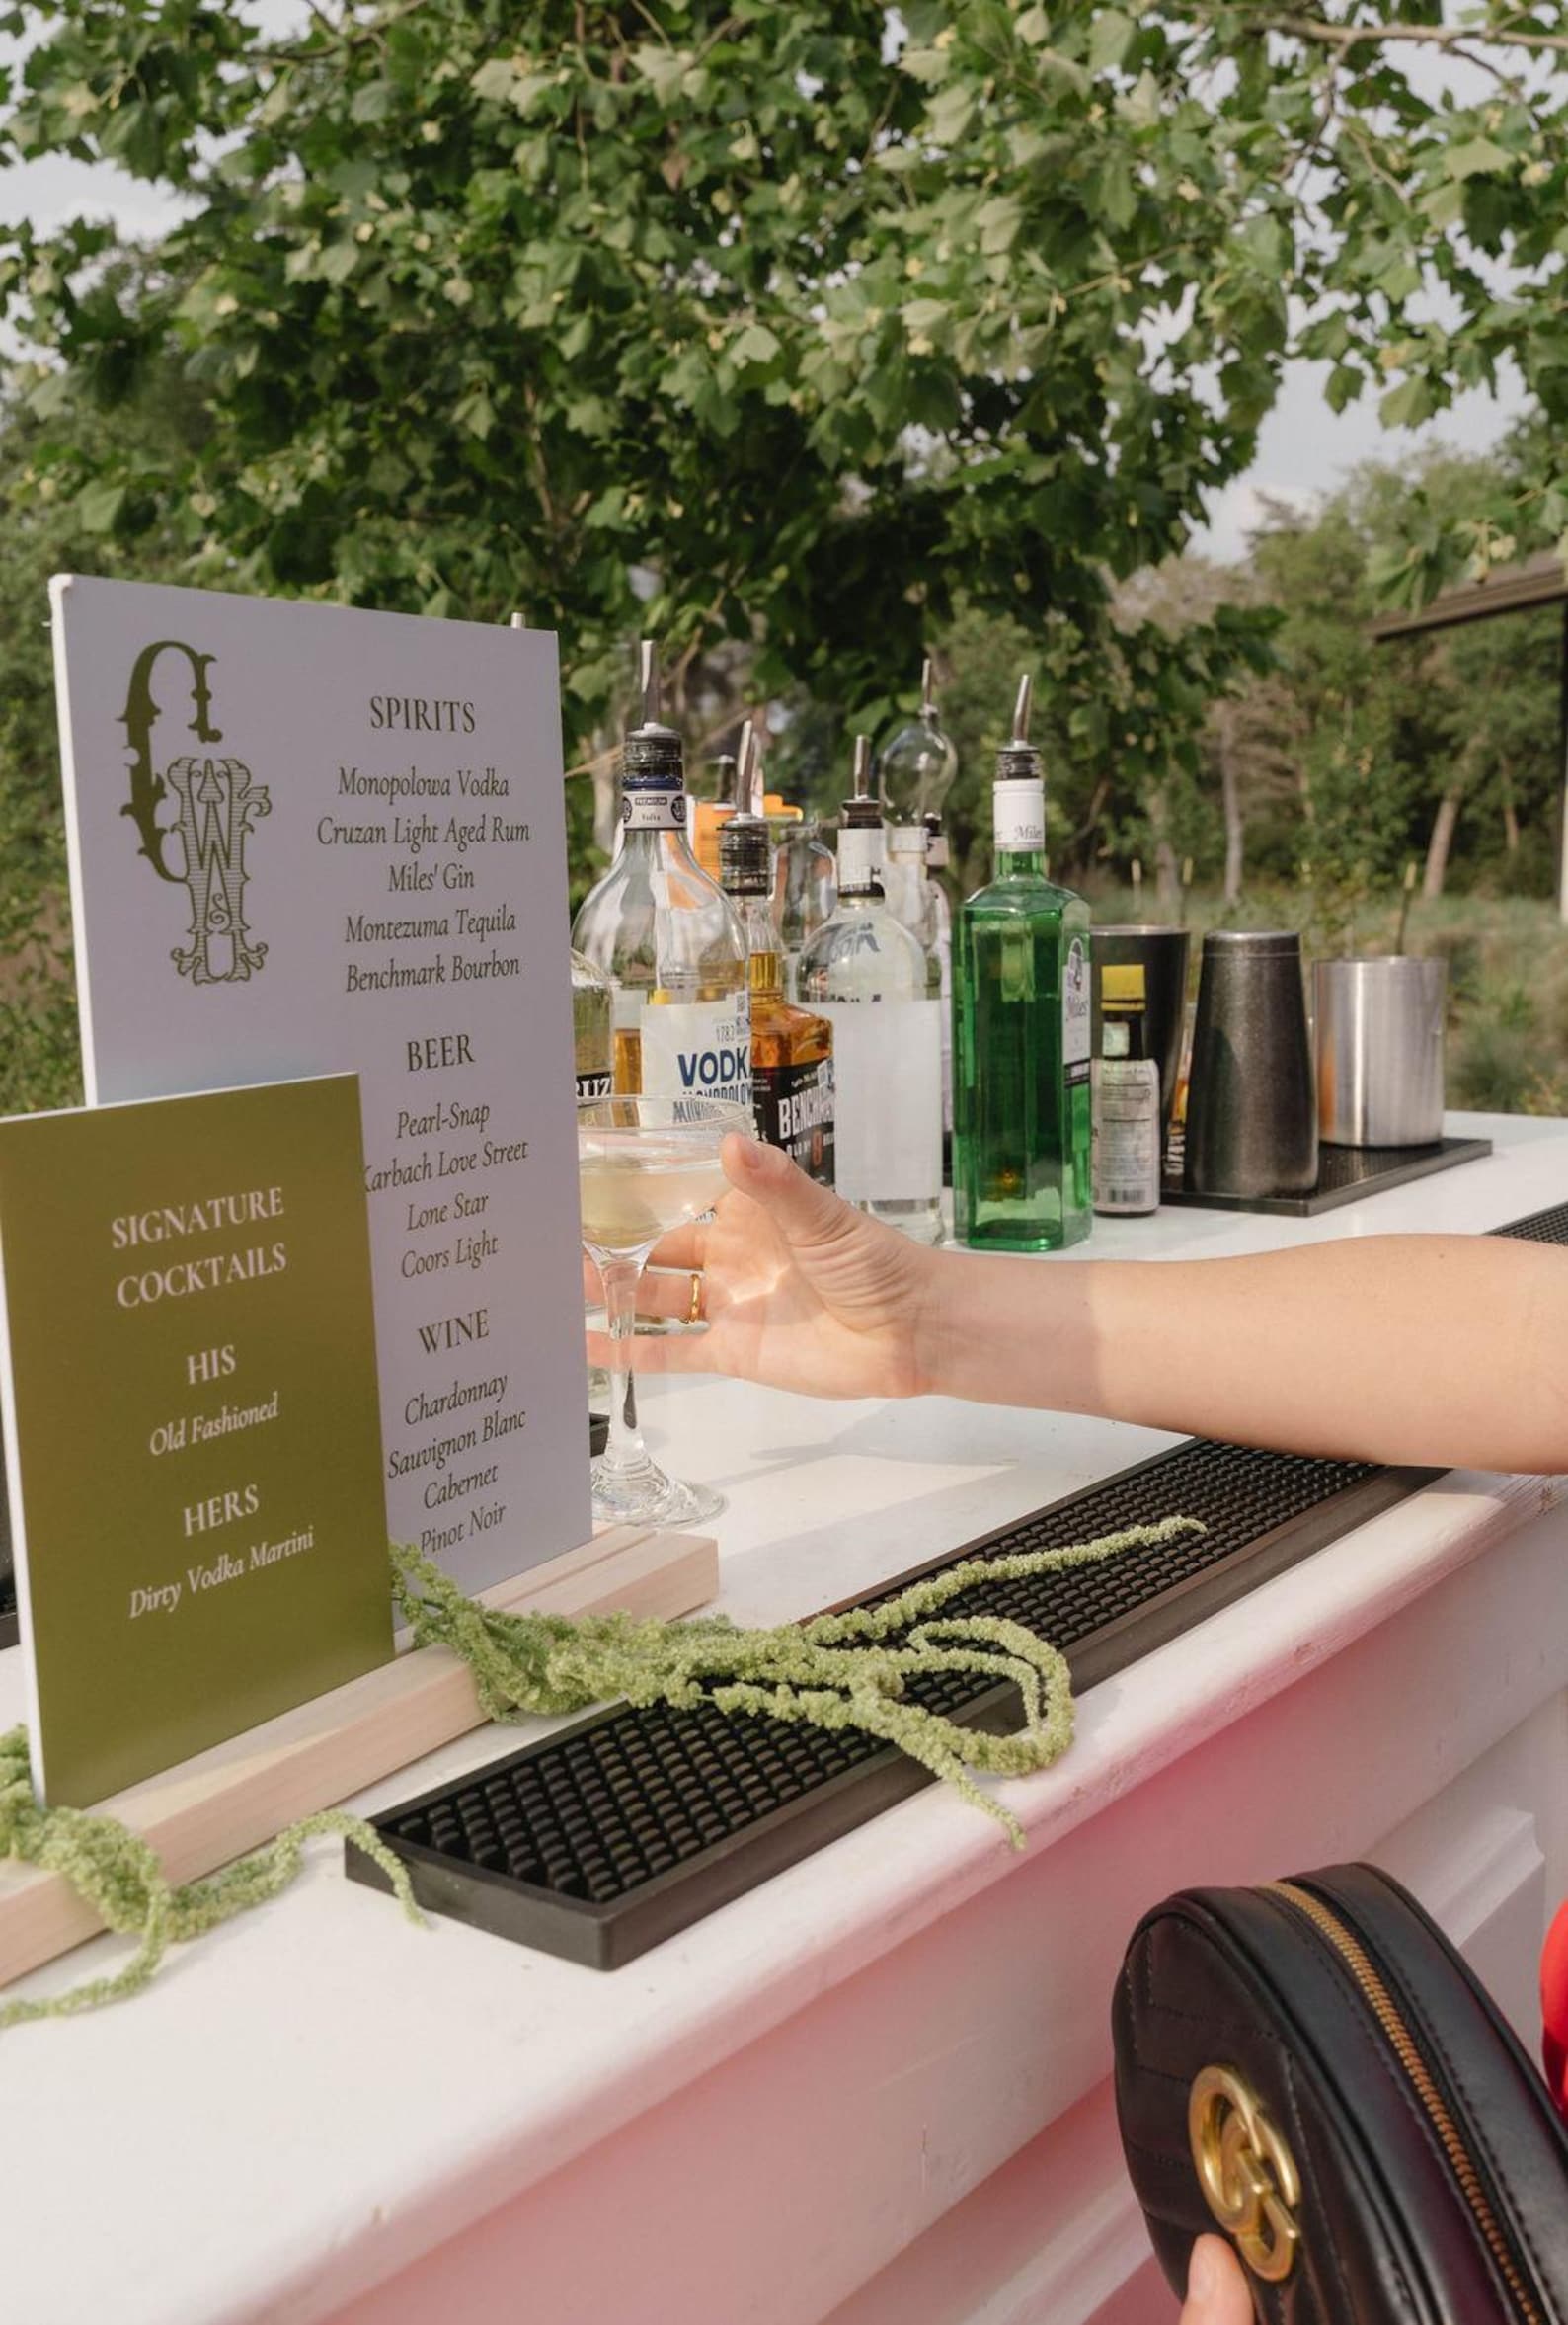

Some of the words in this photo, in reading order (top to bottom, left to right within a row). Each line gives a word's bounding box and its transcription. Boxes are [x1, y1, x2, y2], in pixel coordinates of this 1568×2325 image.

[370, 696, 475, 733] SPIRITS
[338, 766, 450, 806] Monopolowa
[457, 767, 509, 796] Vodka
[317, 817, 387, 844] Cruzan
[393, 815, 439, 854] Light
[443, 814, 486, 853] Aged
[492, 816, 530, 842] Rum
[388, 861, 438, 892] Miles'
[443, 863, 474, 889] Gin
[345, 915, 449, 943] Montezuma
[455, 904, 517, 943] Tequila
[346, 955, 446, 993] Benchmark
[451, 949, 521, 982] Bourbon
[407, 1034, 475, 1072] BEER
[678, 1046, 752, 1087] VODK
[396, 1103, 491, 1140] Pearl-Snap
[437, 1151, 477, 1177] Love
[482, 1141, 528, 1167] Street
[112, 1187, 284, 1249] SIGNATURE
[407, 1204, 448, 1231] Lone
[454, 1192, 489, 1219] Star
[117, 1242, 286, 1309] COCKTAILS
[401, 1250, 450, 1278] Coors
[455, 1229, 498, 1269] Light
[418, 1309, 489, 1354] WINE
[187, 1345, 235, 1385] HIS
[405, 1374, 509, 1426] Chardonnay
[150, 1418, 186, 1456] Old
[191, 1391, 278, 1444] Fashioned
[388, 1429, 478, 1480] Sauvignon
[482, 1409, 527, 1444] Blanc
[424, 1464, 499, 1510] Cabernet
[184, 1484, 259, 1536] HERS
[420, 1523, 465, 1557] Pinot
[470, 1501, 507, 1537] Noir
[129, 1582, 181, 1619] Dirty
[187, 1553, 244, 1593] Vodka
[250, 1525, 313, 1570] Martini
